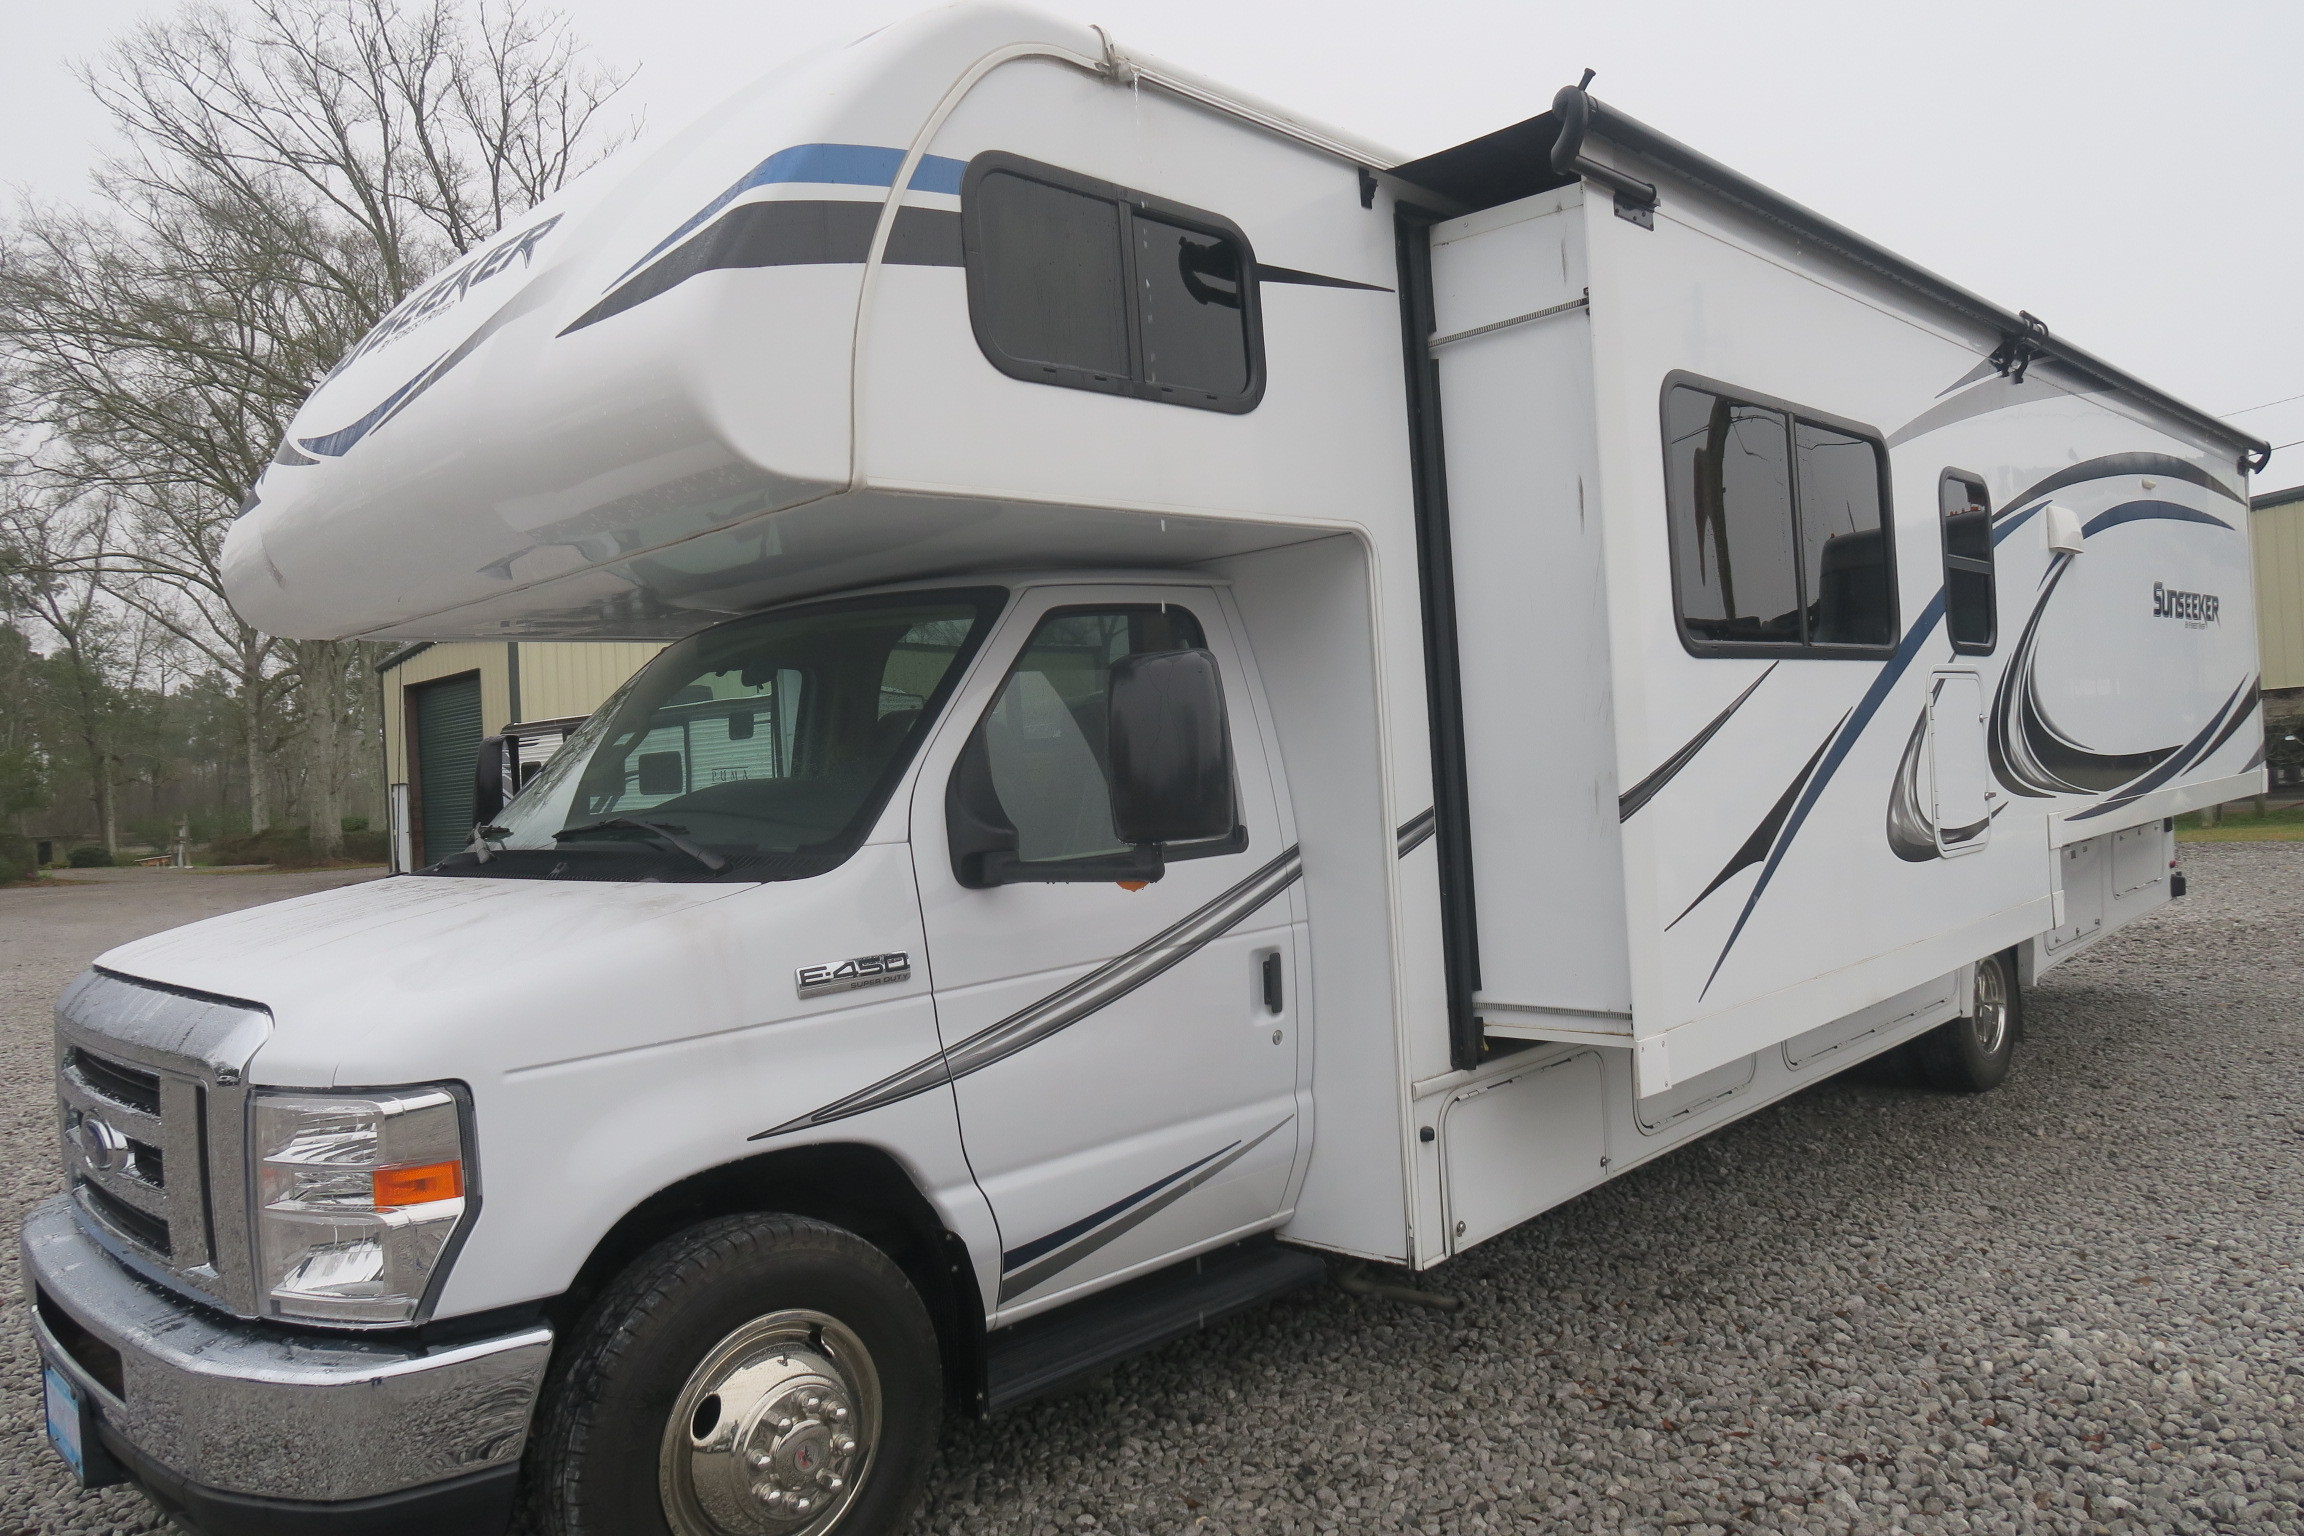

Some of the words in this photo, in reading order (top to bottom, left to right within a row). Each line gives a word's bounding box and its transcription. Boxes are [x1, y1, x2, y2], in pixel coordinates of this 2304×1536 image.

[711, 769, 749, 782] PUMA
[850, 978, 882, 989] SUPER
[883, 972, 909, 983] DUTY
